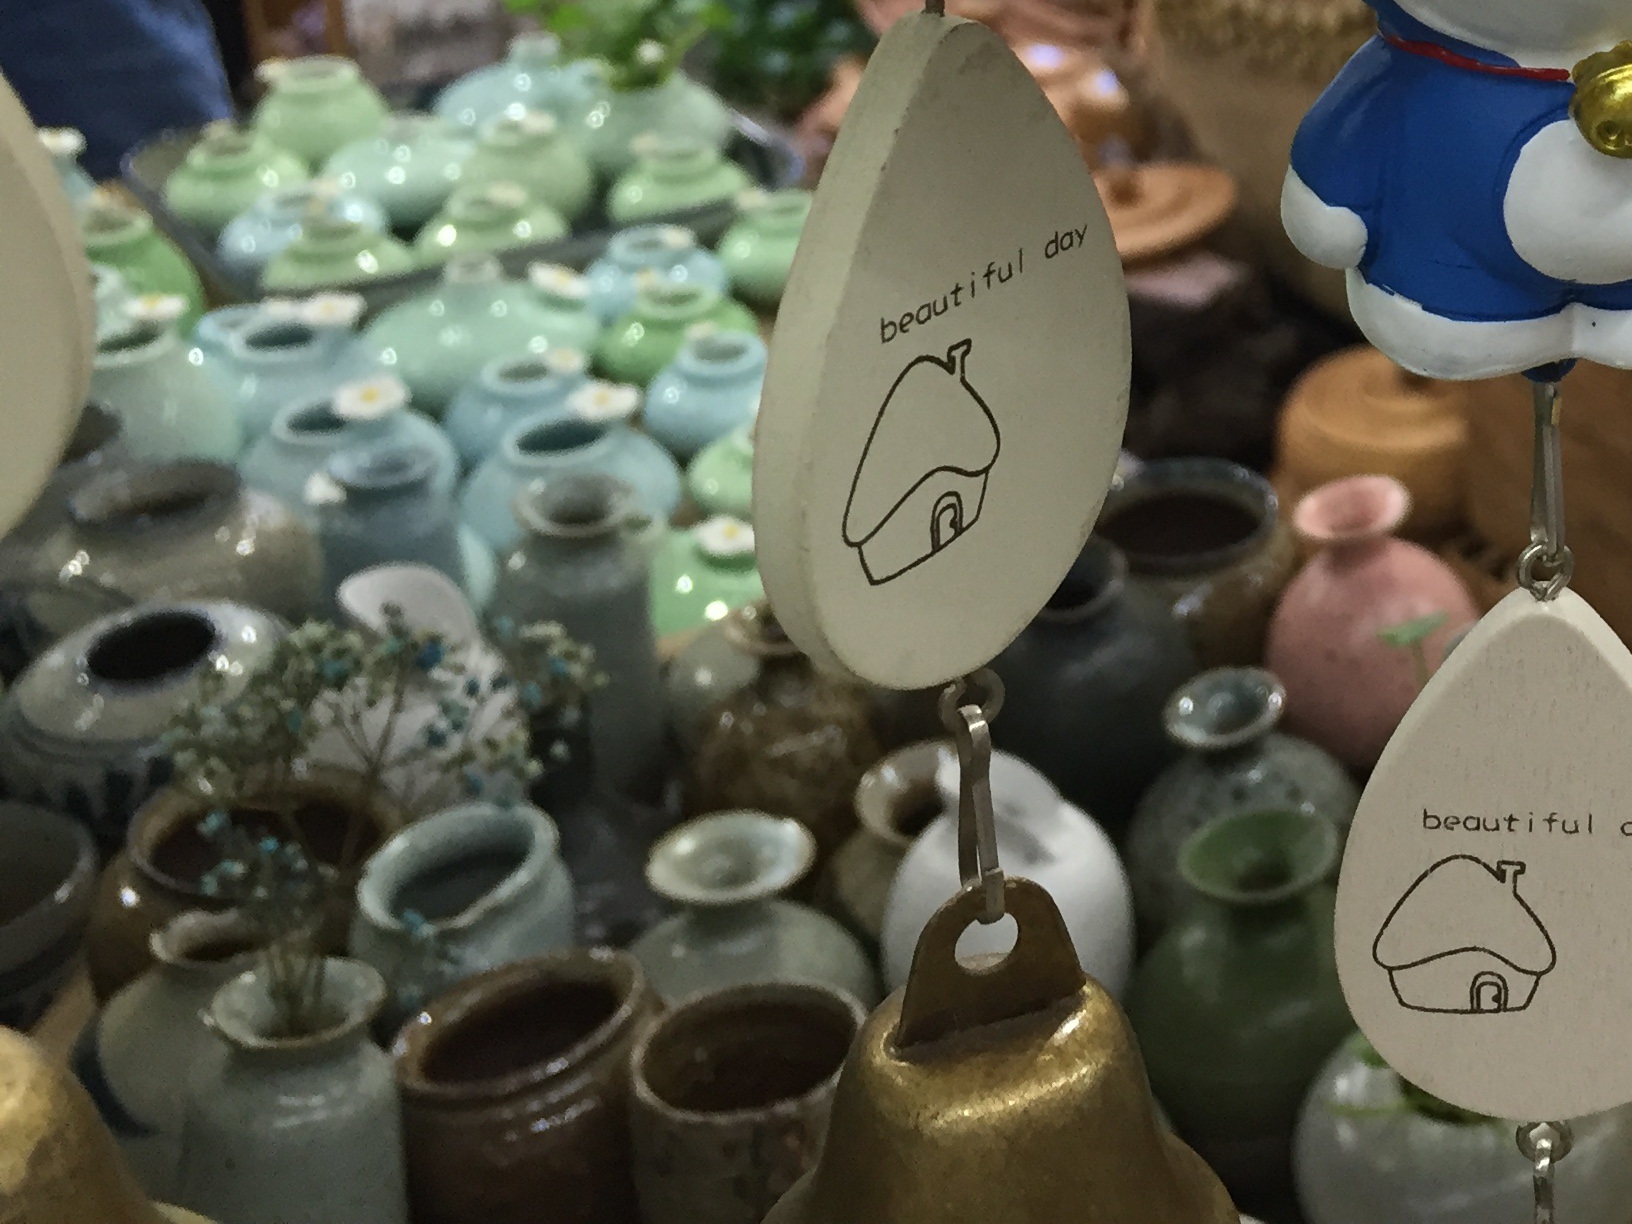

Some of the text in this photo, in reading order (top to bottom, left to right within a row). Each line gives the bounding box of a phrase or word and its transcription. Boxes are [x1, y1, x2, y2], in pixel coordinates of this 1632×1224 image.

[879, 223, 1089, 344] beautiful day
[1422, 808, 1593, 835] beautiful
